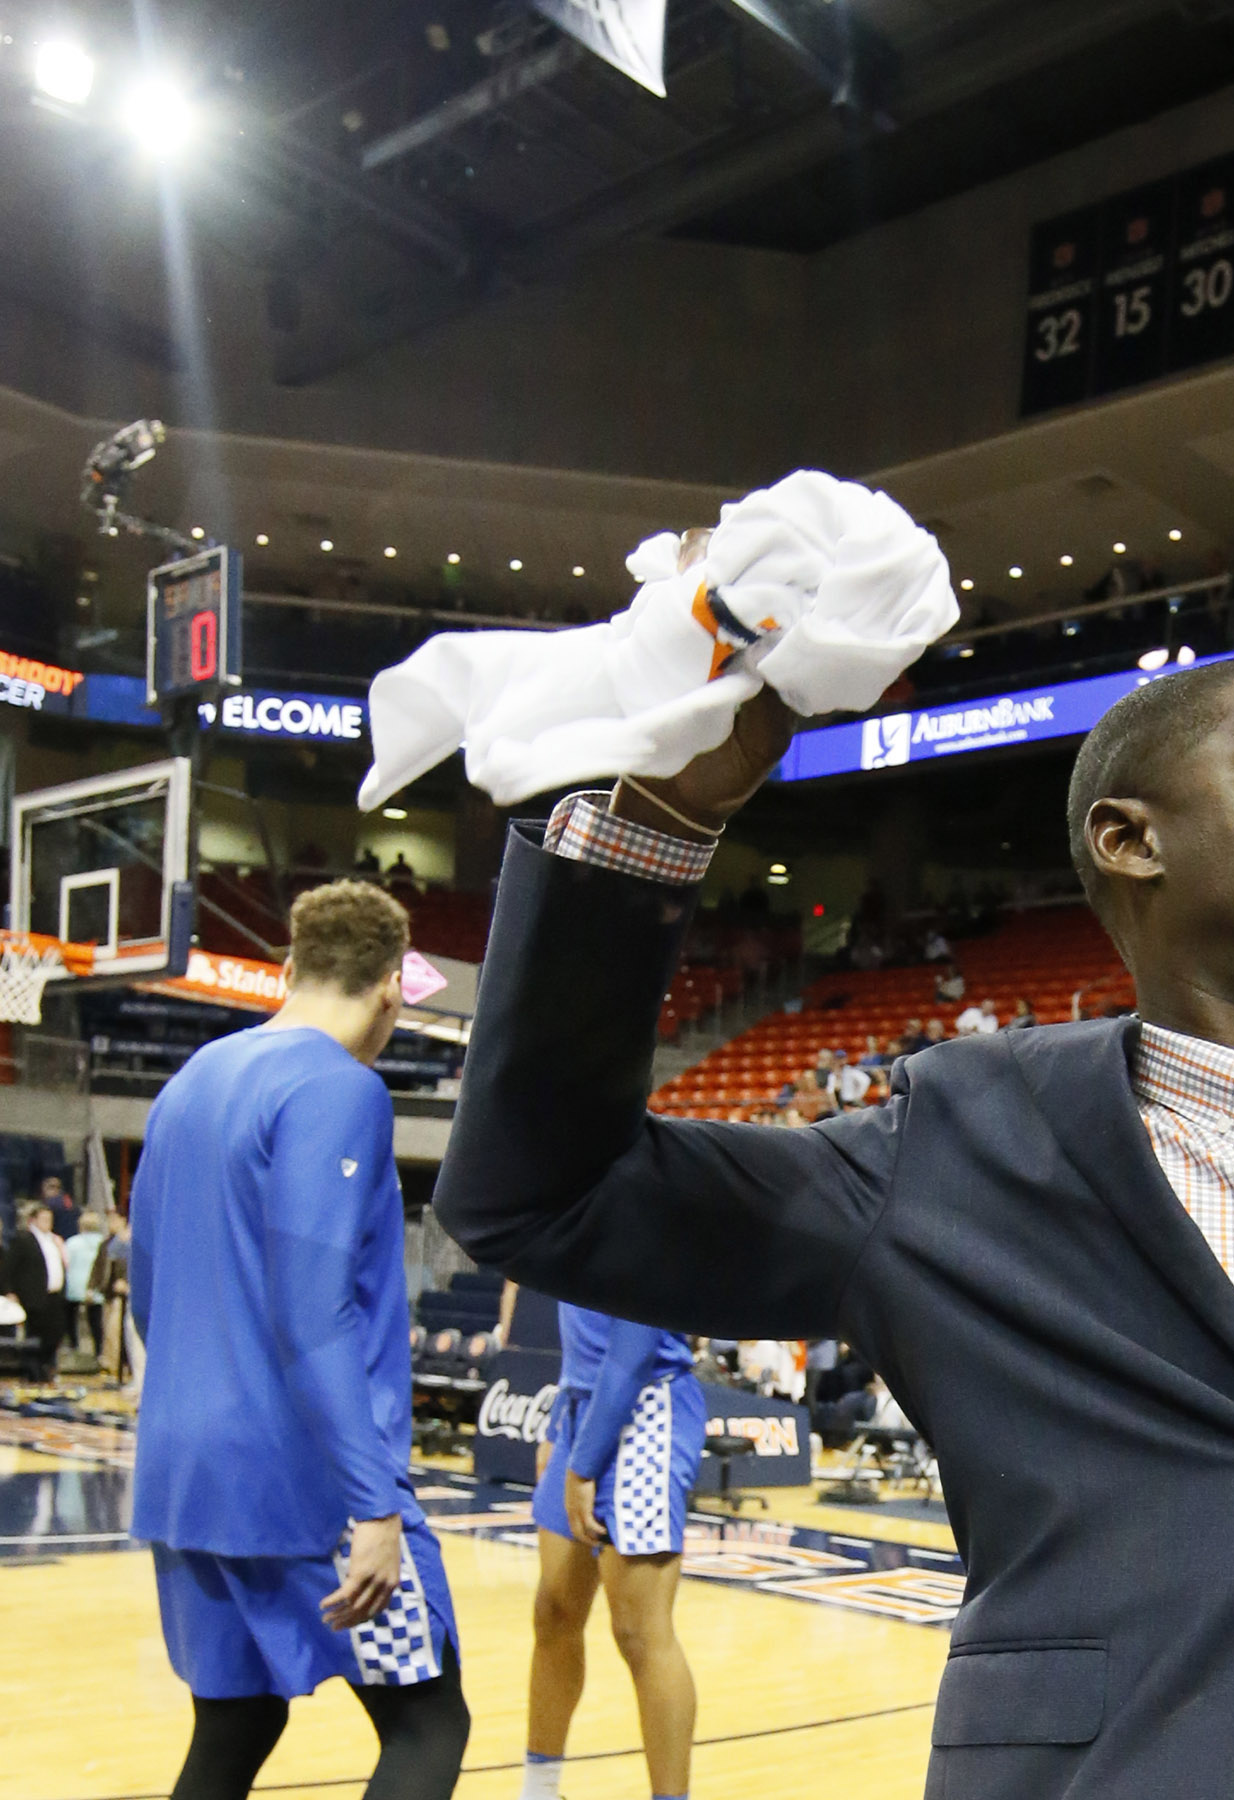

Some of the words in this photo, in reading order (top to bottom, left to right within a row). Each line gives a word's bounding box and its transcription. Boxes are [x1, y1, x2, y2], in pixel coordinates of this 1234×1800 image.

[1114, 285, 1152, 339] 15
[1181, 259, 1233, 317] 30
[1035, 308, 1081, 362] 32
[191, 610, 217, 681] 0
